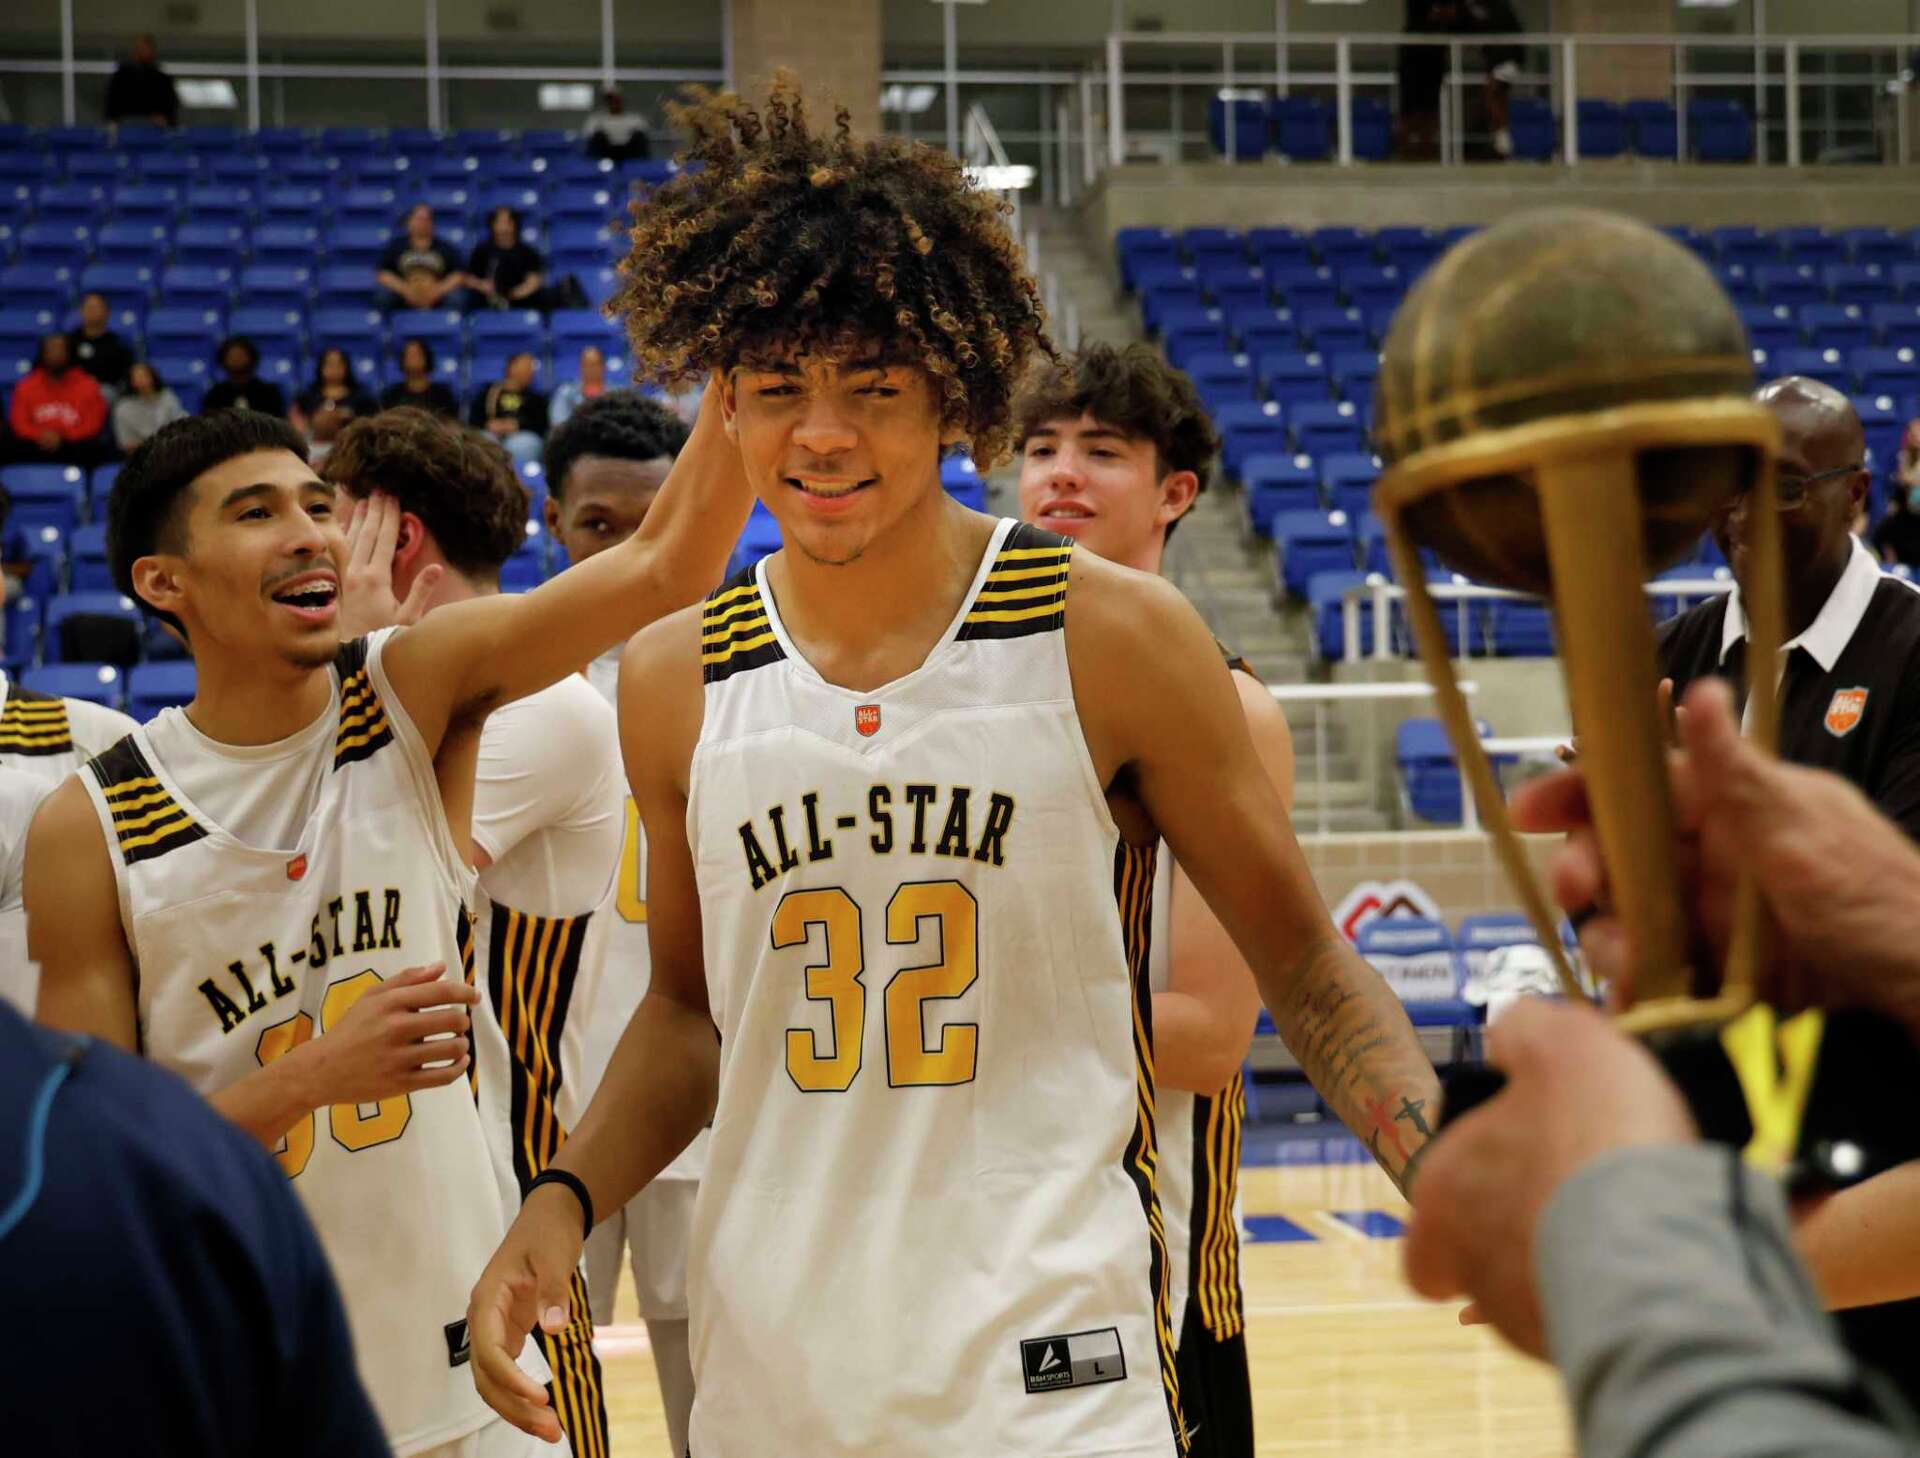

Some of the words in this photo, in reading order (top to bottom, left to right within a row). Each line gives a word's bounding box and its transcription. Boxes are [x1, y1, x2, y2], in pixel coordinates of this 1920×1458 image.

[738, 784, 1015, 890] ALL-STAR
[198, 887, 402, 1034] ALL-STAR
[771, 879, 979, 1092] 32
[1095, 1362, 1104, 1375] L
